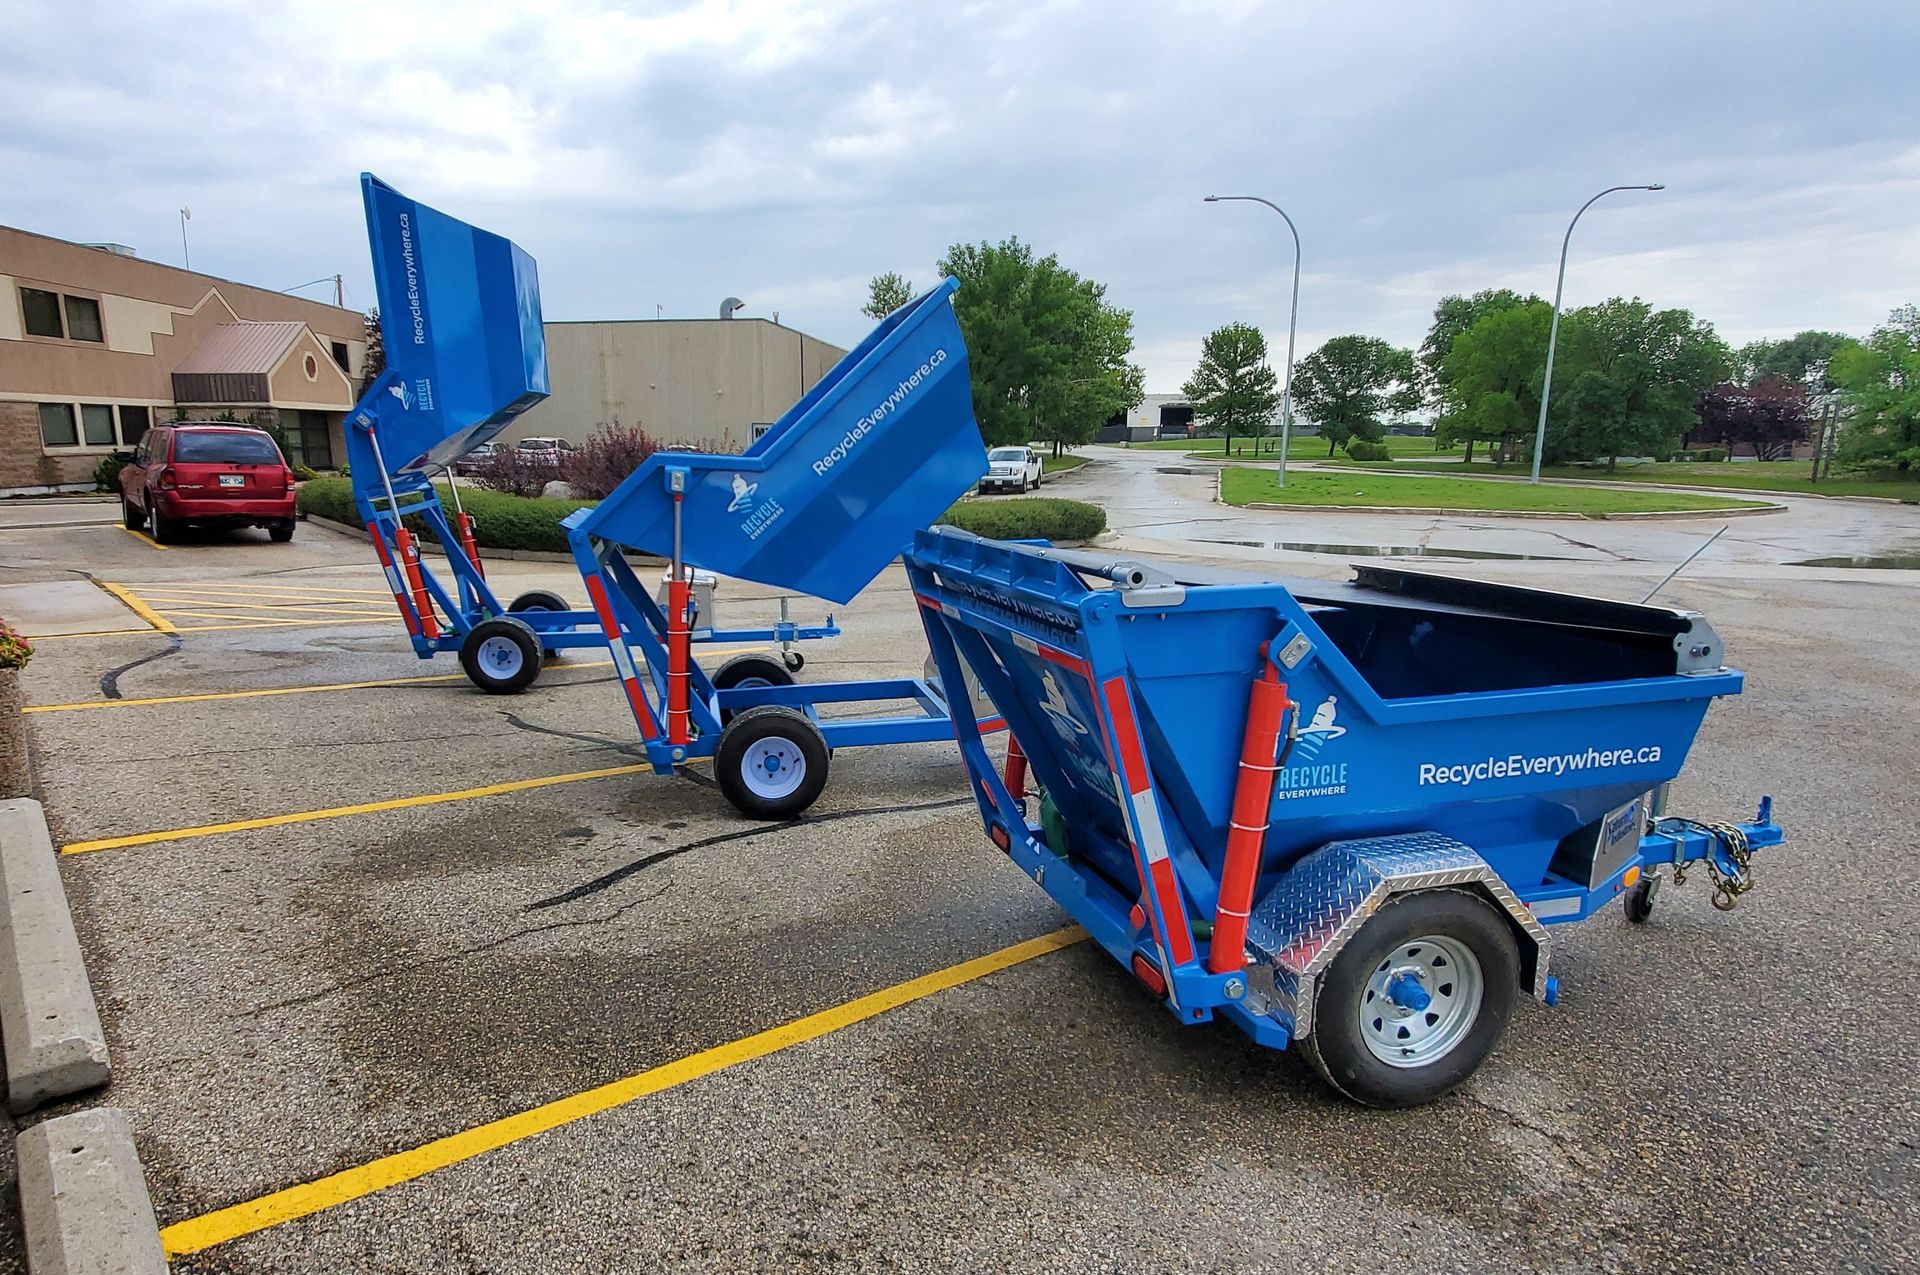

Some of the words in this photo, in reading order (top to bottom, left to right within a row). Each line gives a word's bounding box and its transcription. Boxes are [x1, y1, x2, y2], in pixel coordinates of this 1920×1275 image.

[400, 213, 425, 344] RecycleEverywhere.ca
[812, 349, 947, 476] RecycleEverywhere.ca
[740, 496, 780, 535] RECYCLE
[1280, 763, 1347, 789] RECYCLE
[1419, 746, 1661, 786] RecycleEverywhere.ca
[1279, 785, 1347, 800] EVERYWHERE
